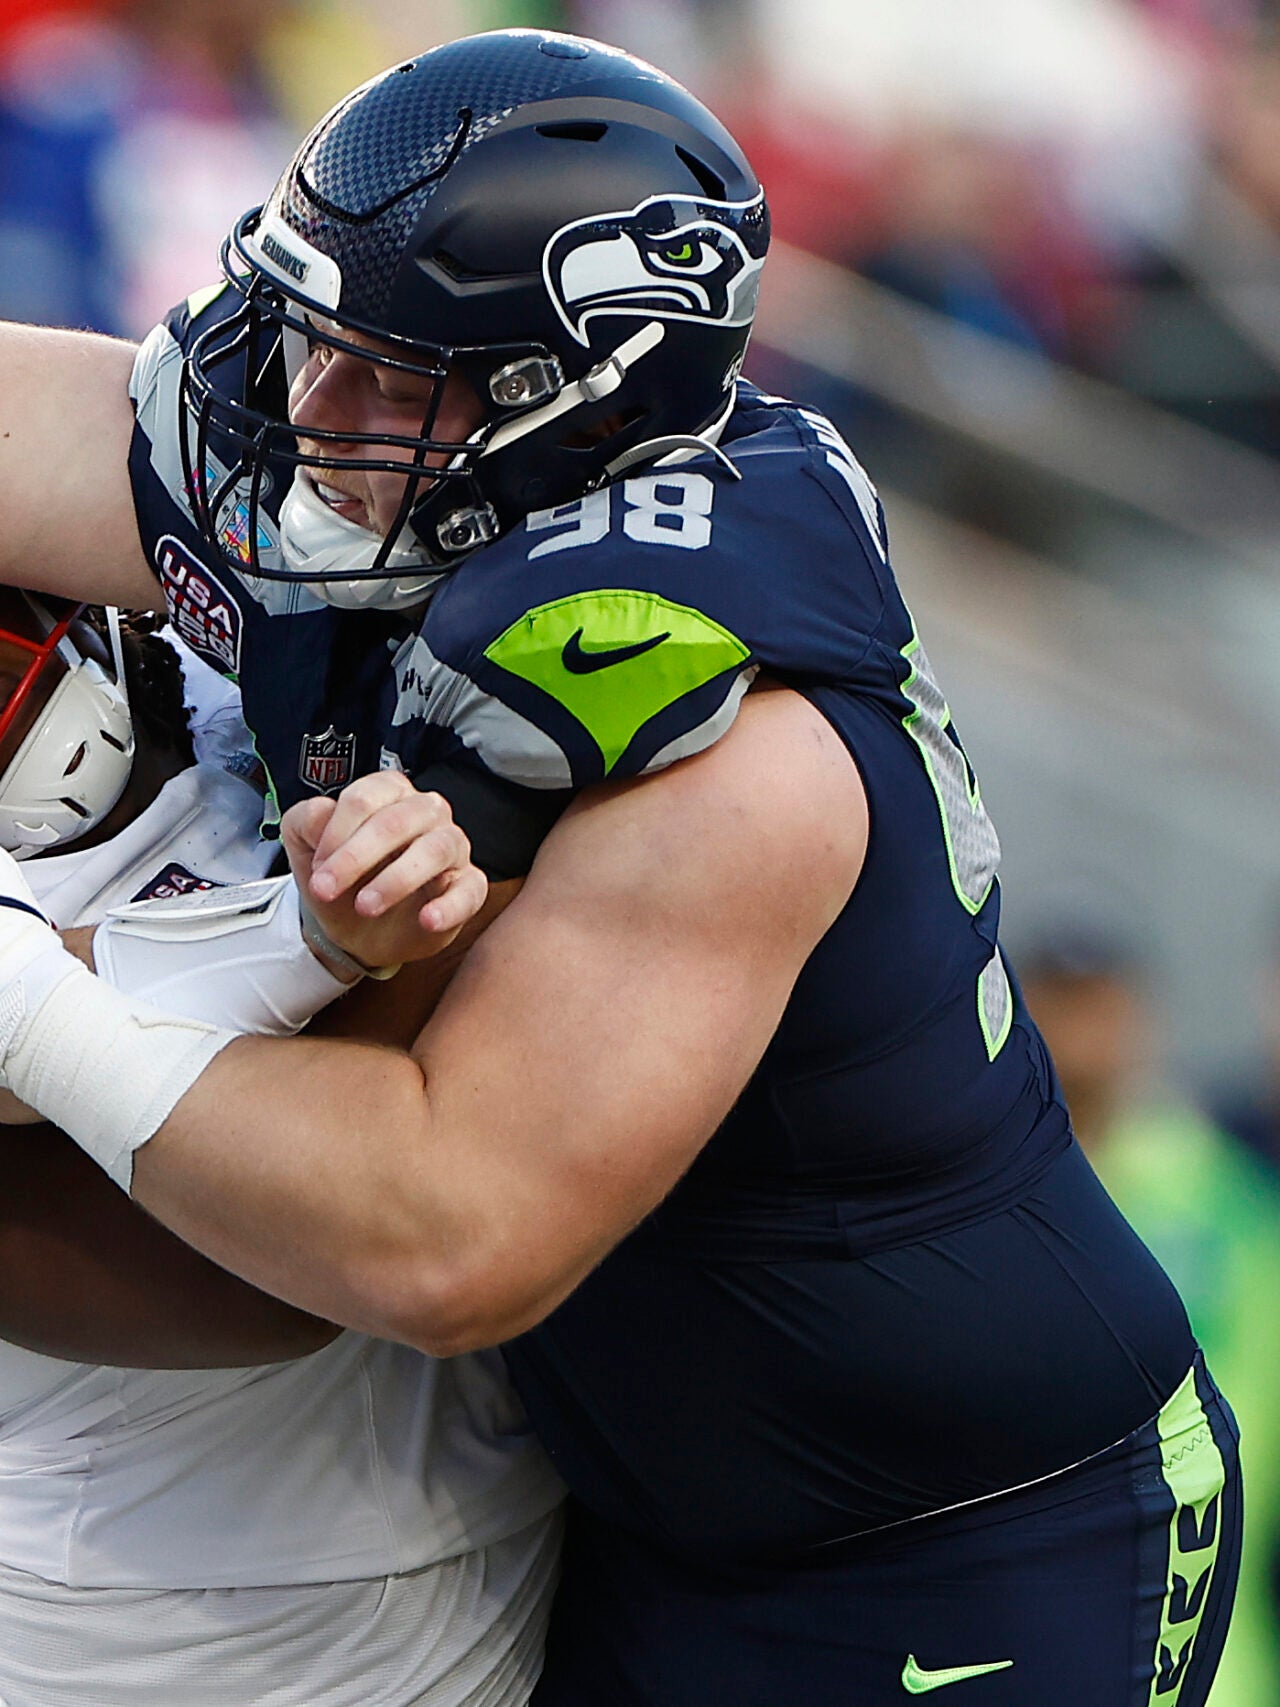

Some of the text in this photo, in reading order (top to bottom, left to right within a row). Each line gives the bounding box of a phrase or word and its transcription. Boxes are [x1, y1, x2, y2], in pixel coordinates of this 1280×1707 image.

[261, 233, 308, 281] SEAHAWKS
[526, 472, 714, 561] 98
[162, 550, 234, 636] USA
[308, 758, 347, 785] NFL
[148, 873, 195, 900] SA
